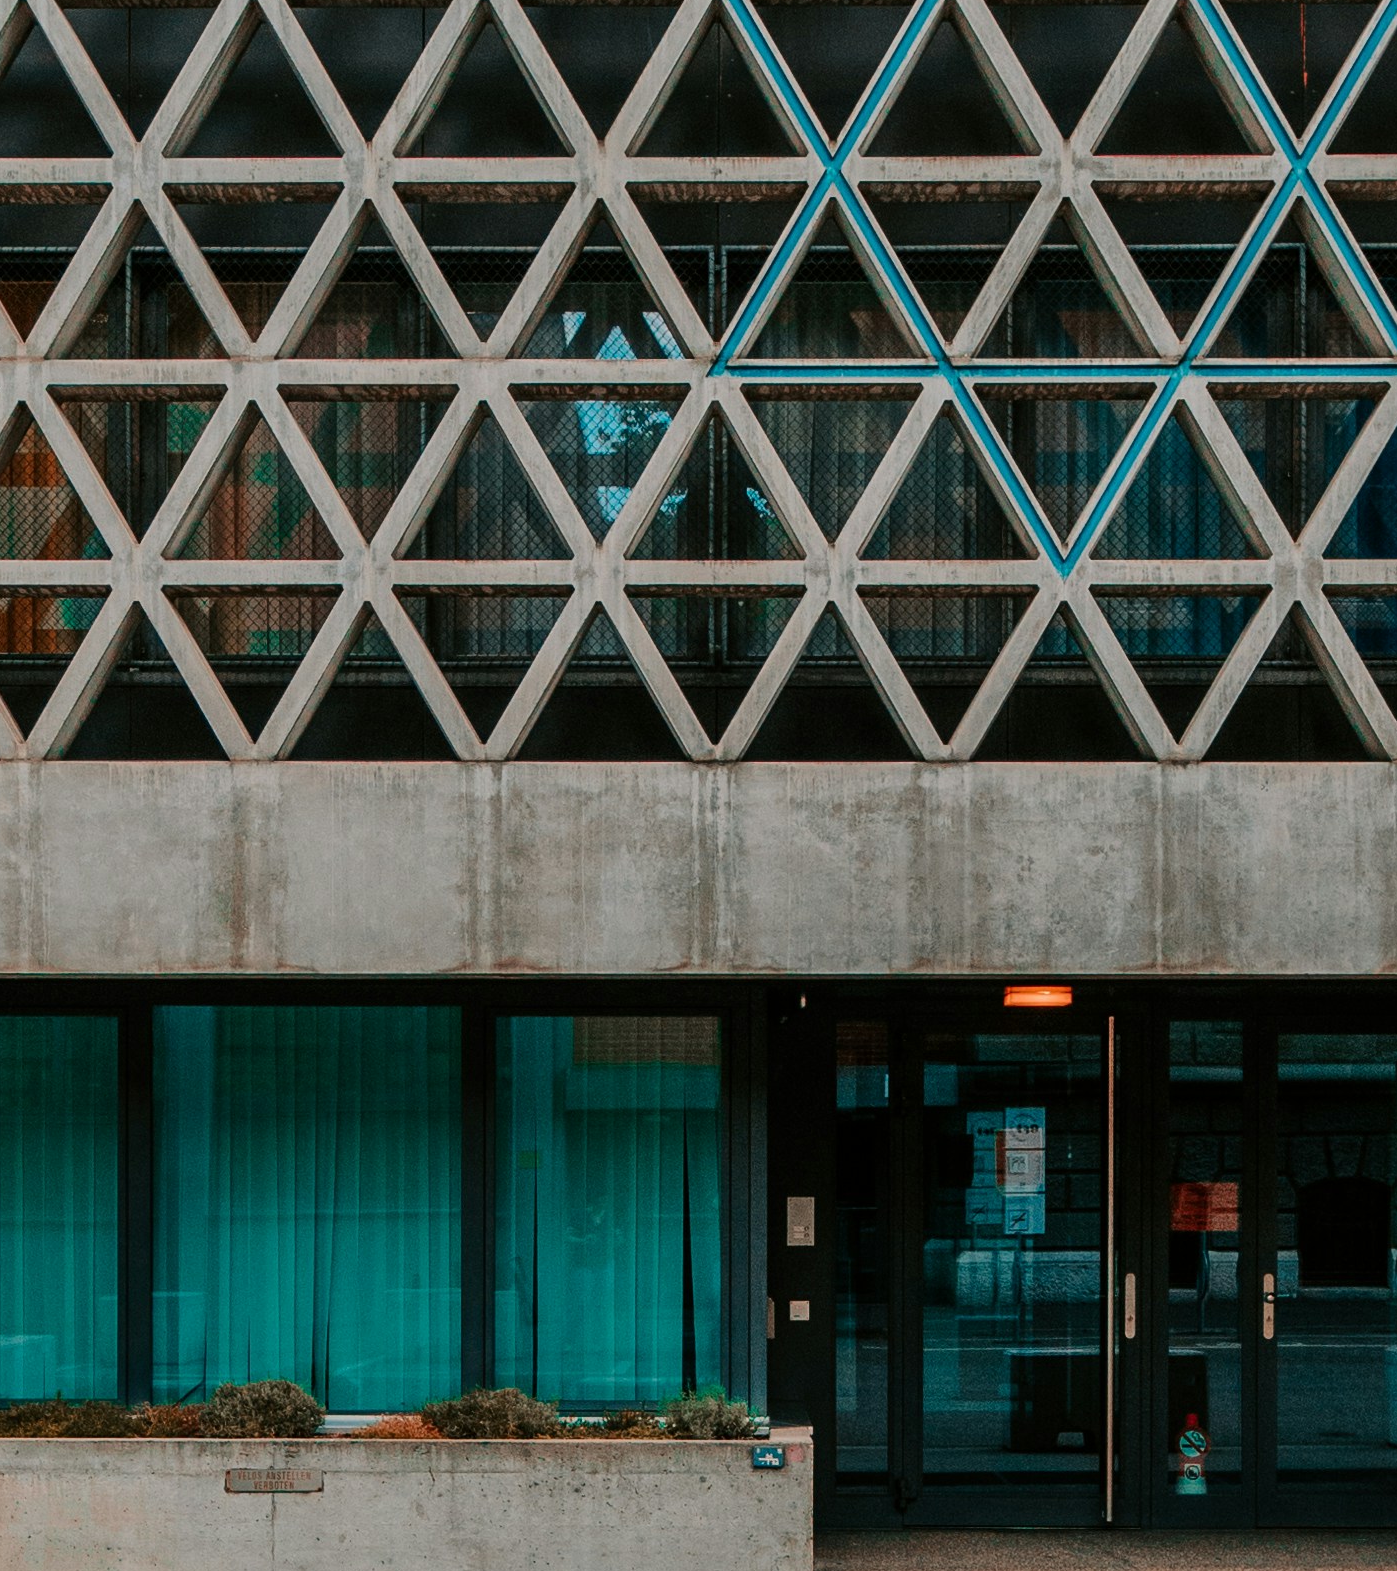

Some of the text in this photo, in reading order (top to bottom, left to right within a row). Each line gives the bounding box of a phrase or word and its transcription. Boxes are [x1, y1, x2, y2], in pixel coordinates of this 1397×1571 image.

[237, 1471, 311, 1480] VELOS ANSTELLEN
[254, 1481, 294, 1489] VERBOTEN
